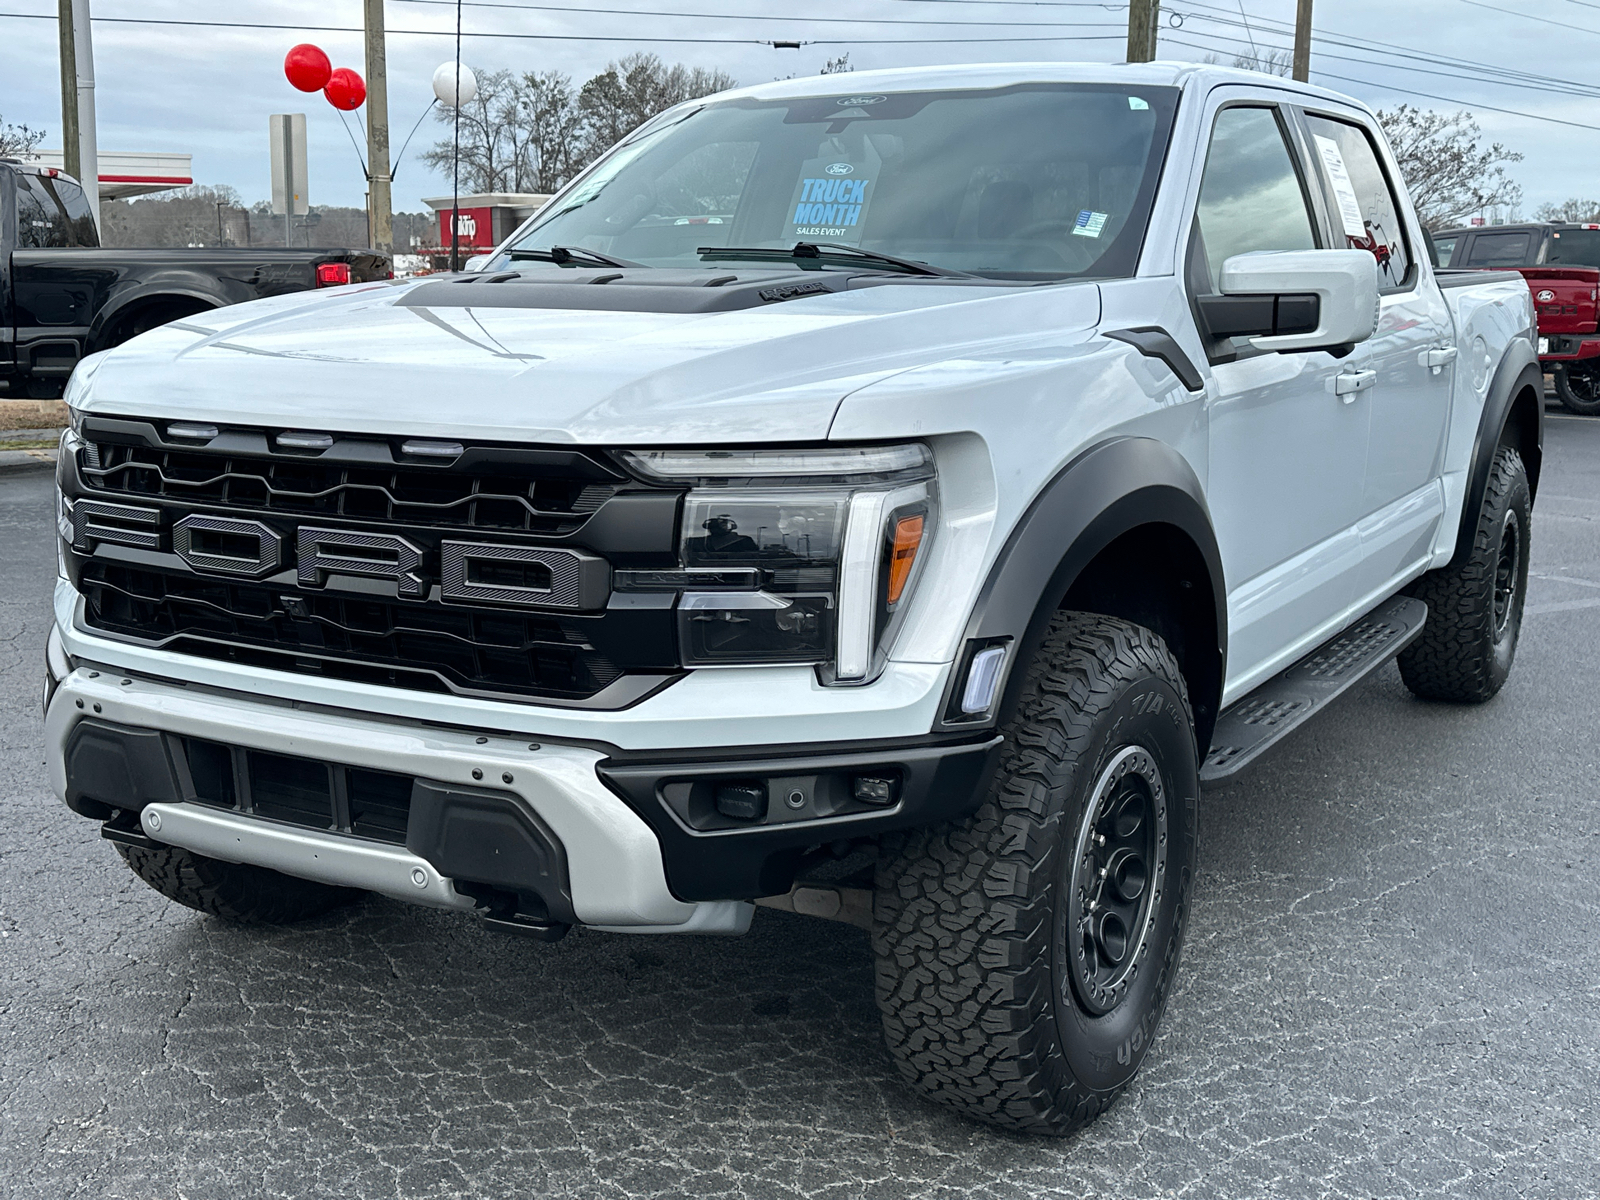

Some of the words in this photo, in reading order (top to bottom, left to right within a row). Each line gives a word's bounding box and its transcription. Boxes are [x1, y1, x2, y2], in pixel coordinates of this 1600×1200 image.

[830, 164, 849, 174] Ford
[800, 178, 869, 203] TRUCK
[449, 214, 476, 240] ikTrip
[793, 203, 862, 227] MONTH
[796, 227, 820, 236] SALES
[820, 228, 846, 237] EVENT
[760, 282, 830, 300] RAPTOR
[72, 498, 594, 612] FORD
